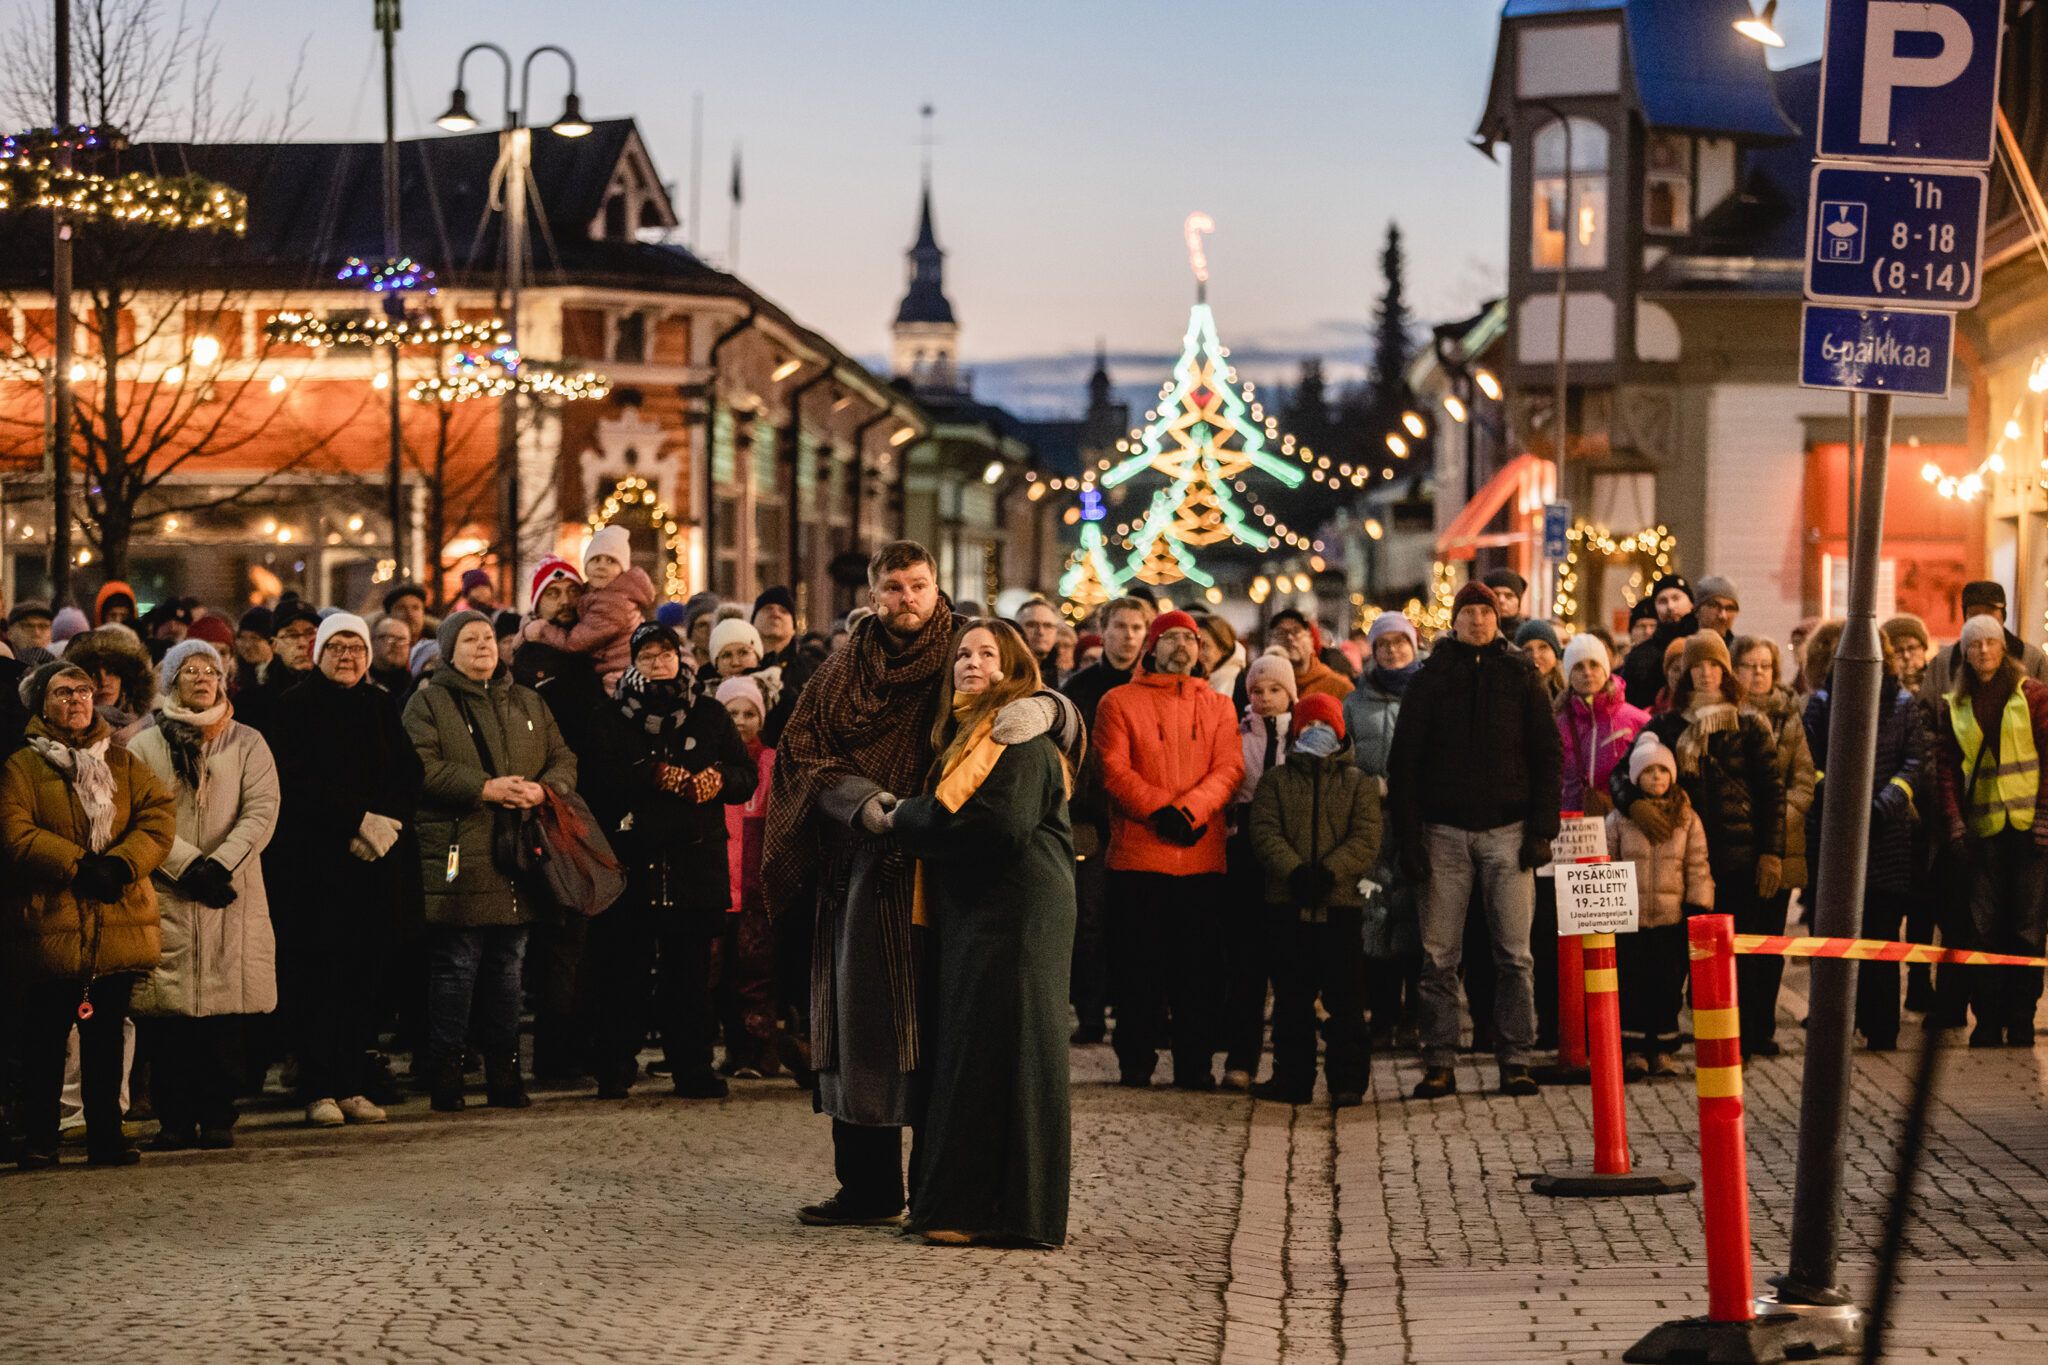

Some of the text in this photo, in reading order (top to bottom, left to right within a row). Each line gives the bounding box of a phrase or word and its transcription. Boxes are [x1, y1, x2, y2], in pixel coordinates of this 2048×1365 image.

[1859, 1, 1974, 145] P
[1835, 241, 1849, 257] P
[1841, 335, 1932, 369] paikkaa
[1567, 867, 1628, 881] PYSÄKÖINTI
[1572, 883, 1627, 894] KIELLETTY
